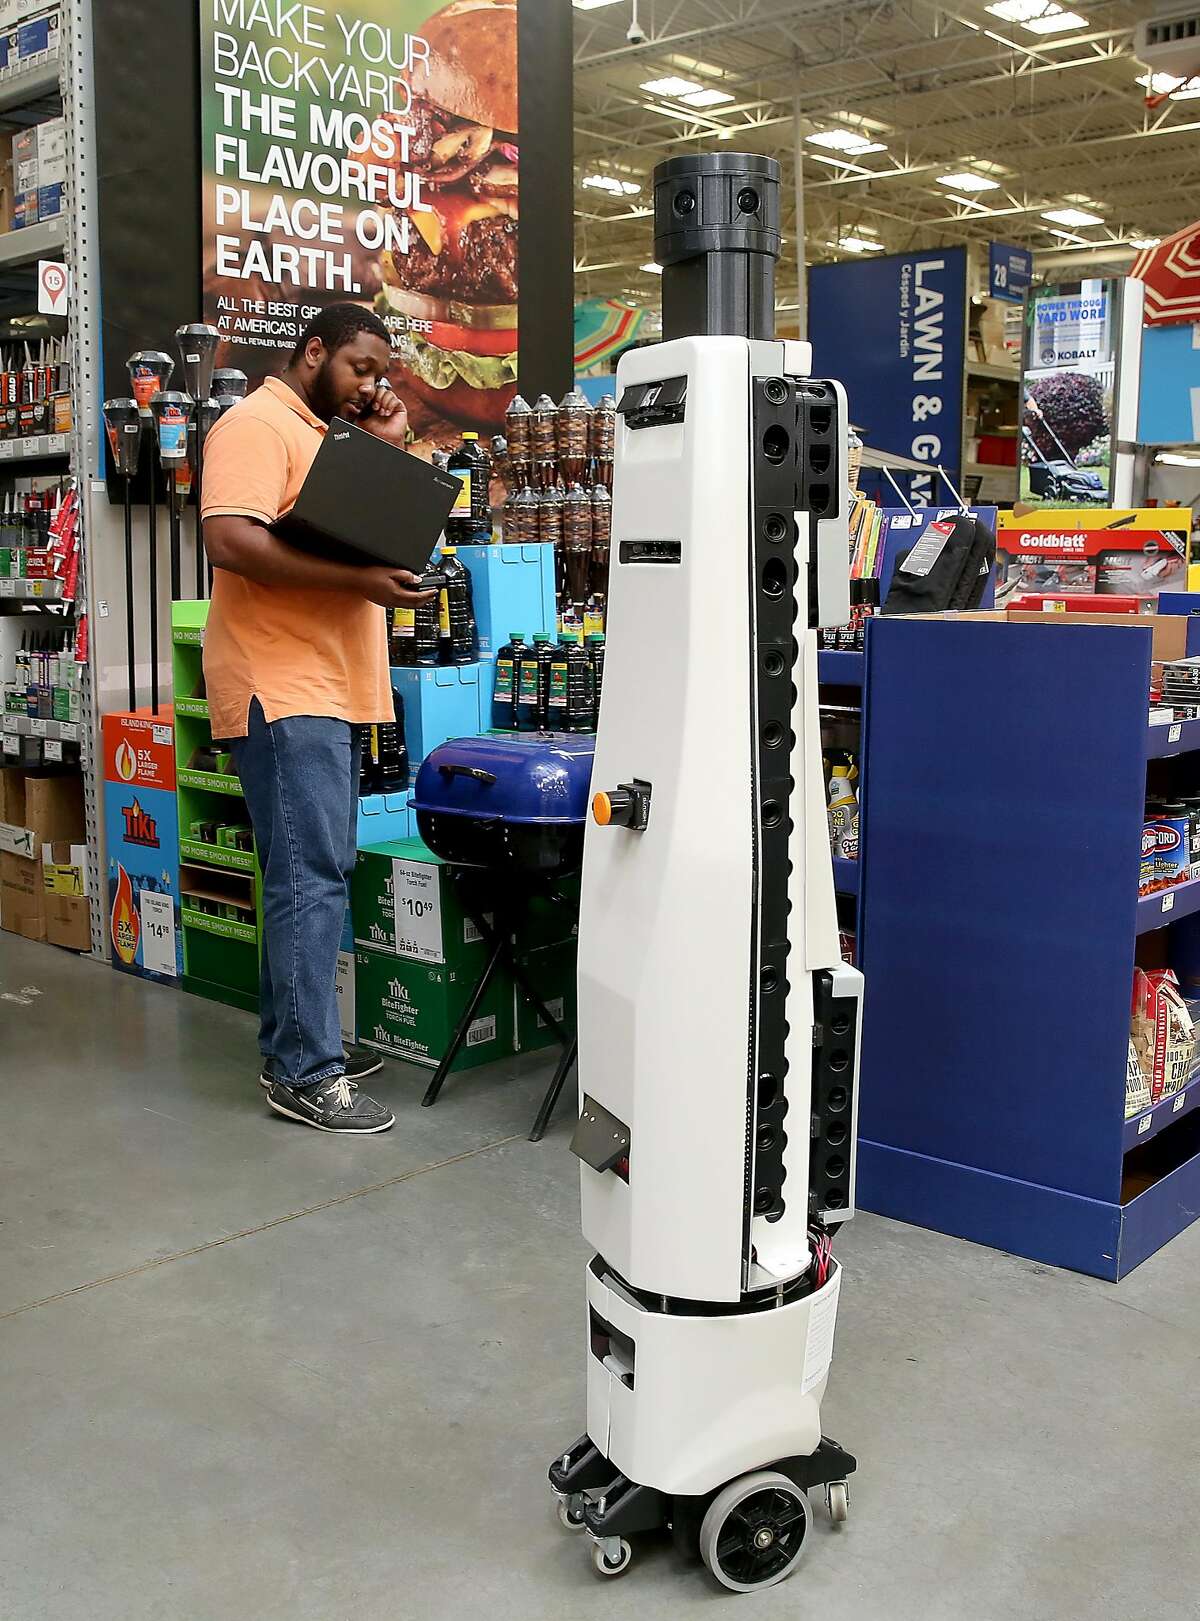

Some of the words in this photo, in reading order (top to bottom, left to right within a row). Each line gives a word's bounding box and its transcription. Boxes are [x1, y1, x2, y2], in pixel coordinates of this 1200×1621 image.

[213, 0, 326, 49] MAKE
[336, 14, 430, 76] YOUR
[214, 32, 413, 116] BACKYARD
[214, 83, 297, 140] THE
[310, 105, 416, 164] MOST
[215, 134, 432, 213] FLAVORFUL
[216, 184, 344, 244] PLACE
[355, 209, 409, 254] ON
[216, 235, 361, 293] EARTH.
[994, 264, 1007, 288] 28
[48, 276, 60, 286] 15
[217, 296, 240, 311] ALL
[241, 298, 265, 314] THE
[268, 302, 299, 318] BEST
[384, 315, 406, 330] ARE
[406, 319, 433, 333] HERE
[217, 315, 232, 329] AT
[234, 318, 297, 336] AMERICA'S
[912, 259, 945, 382] LAWN
[1037, 311, 1066, 323] YARD
[232, 335, 249, 345] GRILL
[1058, 349, 1097, 361] KOBALT
[912, 395, 942, 423] &
[1019, 533, 1086, 548] Goldblatt
[174, 632, 183, 640] NO
[176, 703, 185, 711] NO
[138, 750, 151, 761] 5X
